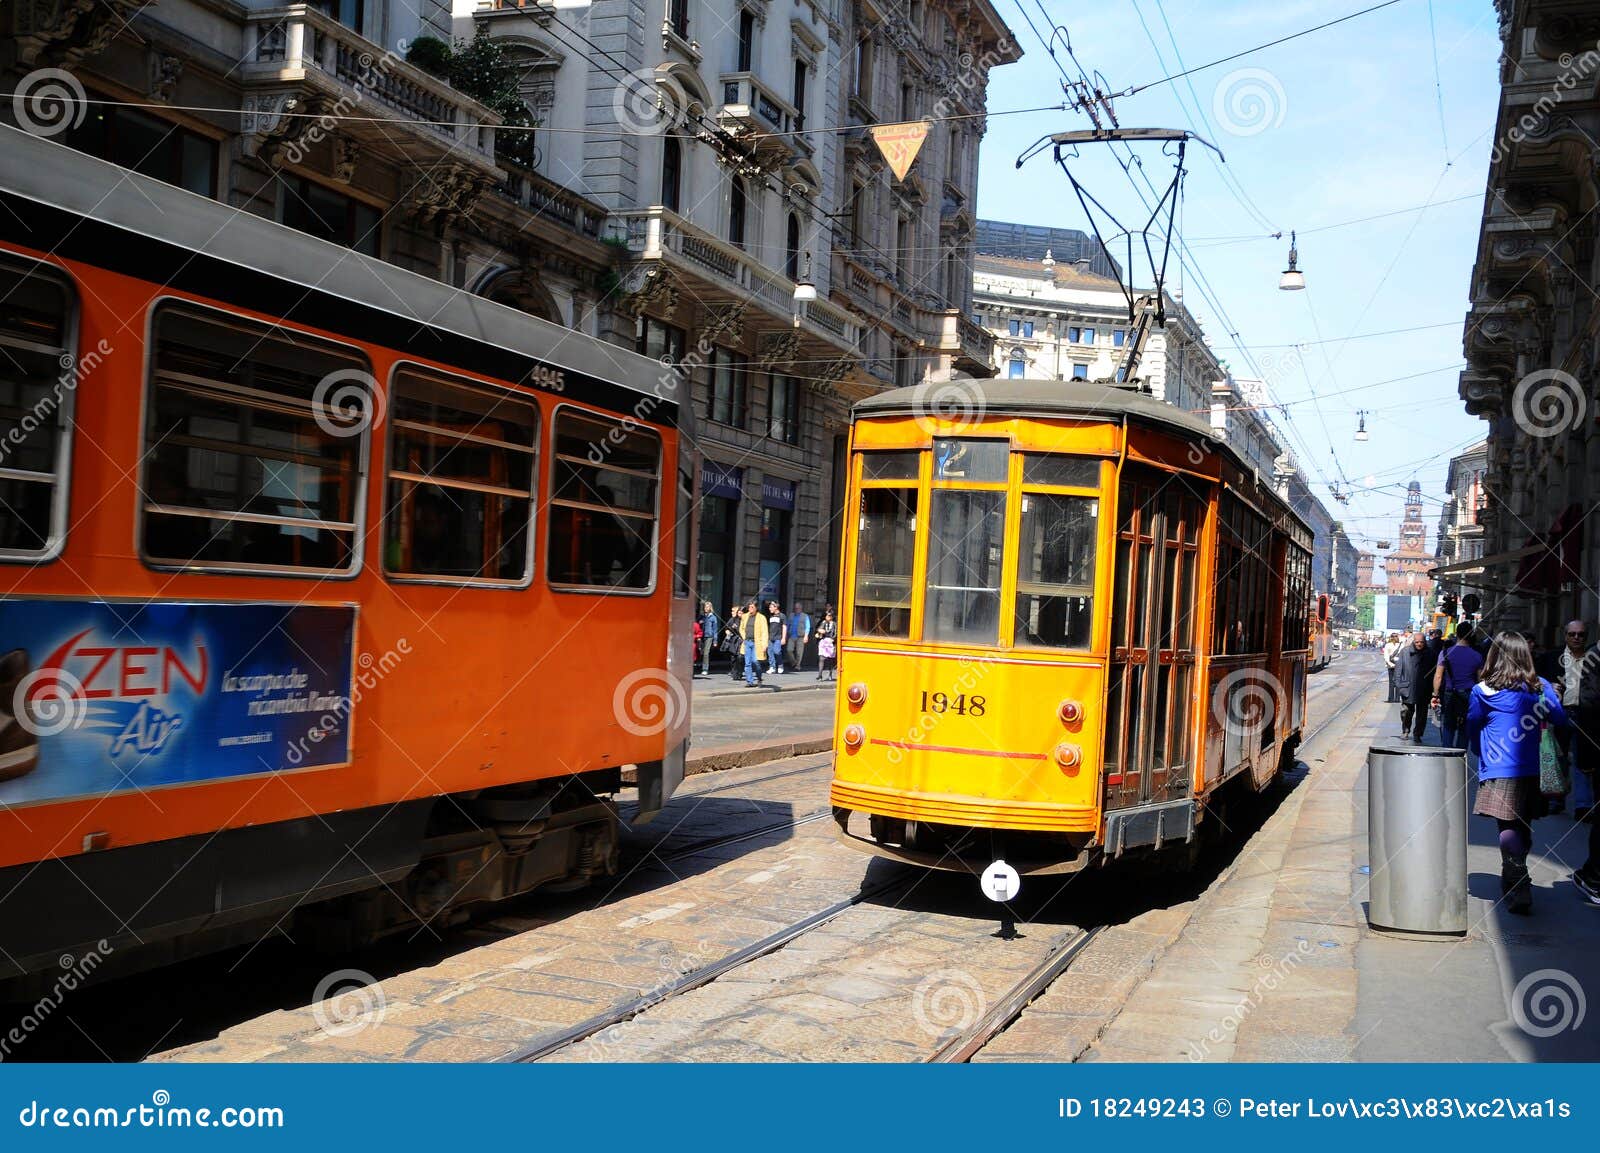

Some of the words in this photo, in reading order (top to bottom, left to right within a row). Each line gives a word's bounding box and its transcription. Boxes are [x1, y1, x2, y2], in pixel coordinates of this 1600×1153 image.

[531, 365, 565, 392] 4945
[70, 644, 209, 699] ZEN
[920, 690, 986, 717] 1948
[111, 699, 182, 757] Air
